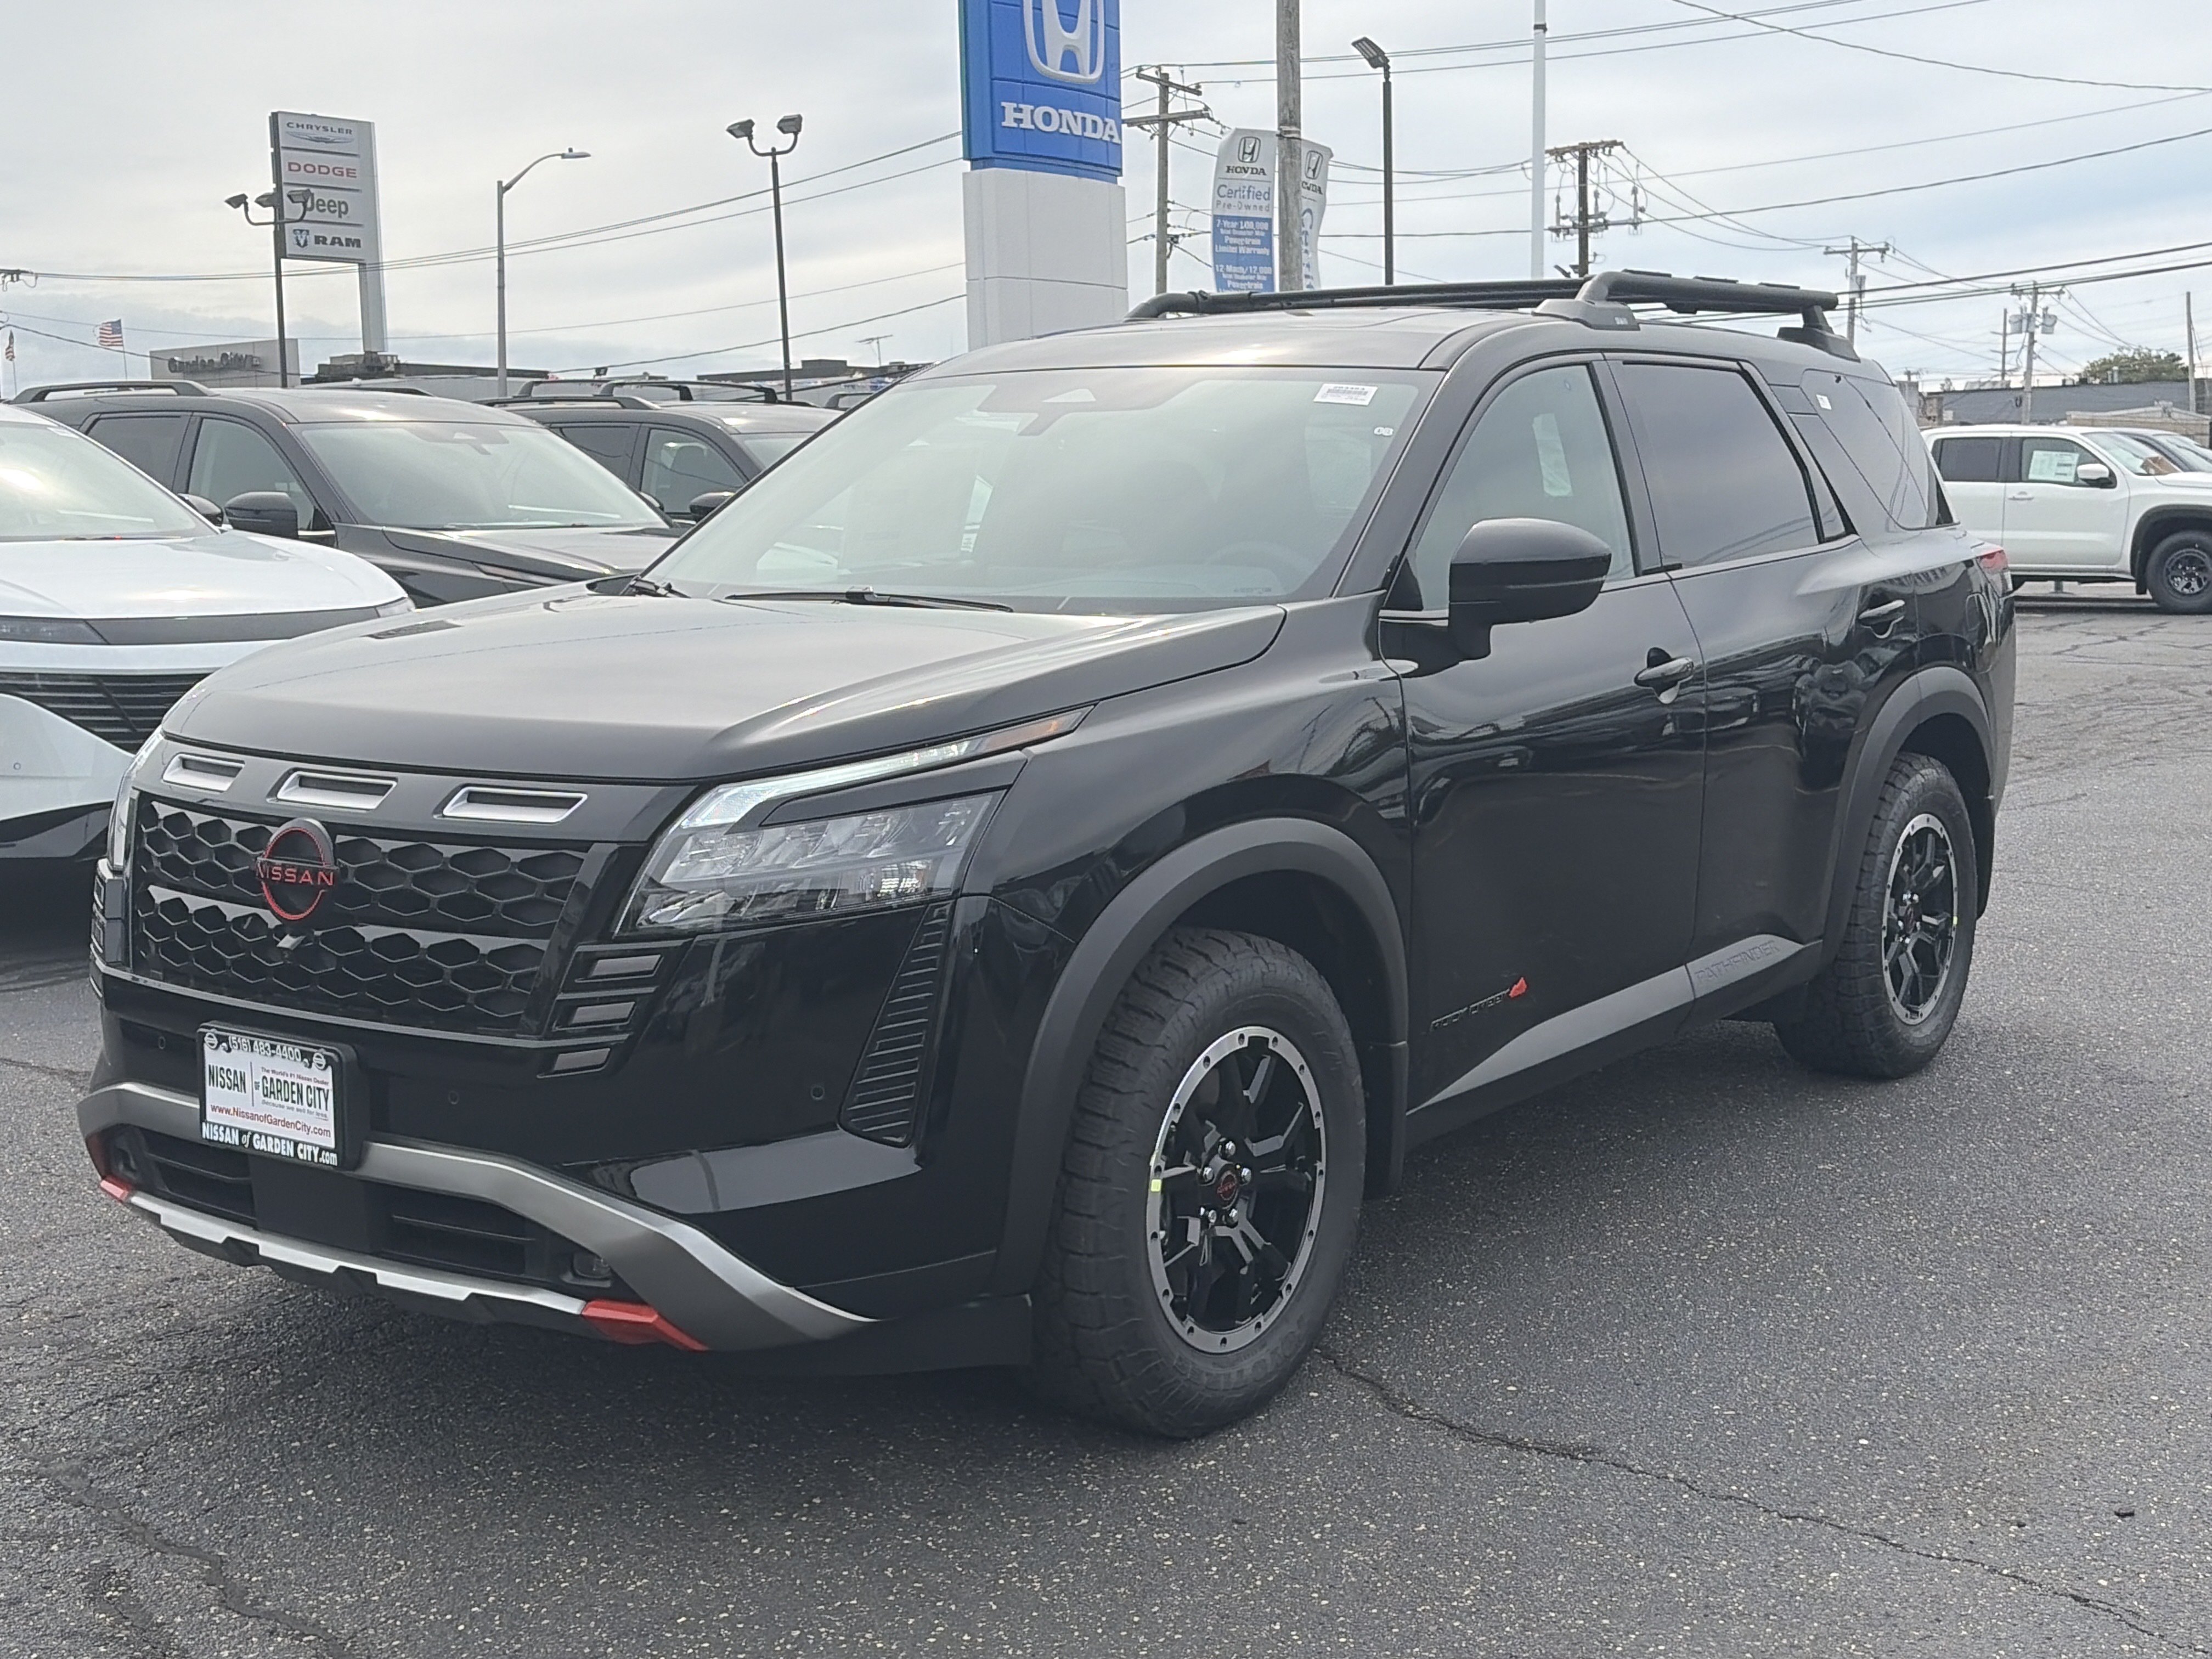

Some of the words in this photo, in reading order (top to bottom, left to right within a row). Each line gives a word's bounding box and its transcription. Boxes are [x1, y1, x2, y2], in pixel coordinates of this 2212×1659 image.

[286, 122, 353, 135] CHRYSLER
[1001, 101, 1121, 144] HONDA
[287, 162, 357, 178] DODGE
[1217, 184, 1271, 201] Certified
[305, 193, 349, 218] Jeep
[1216, 201, 1270, 212] Pre-Owned
[314, 235, 362, 248] RAM
[256, 861, 334, 886] NISSAN
[228, 1035, 251, 1051] (516)
[253, 1042, 301, 1062] 483-4400
[208, 1064, 247, 1094] NISSAN
[271, 1069, 289, 1077] World's
[262, 1075, 303, 1106] GARDEN
[306, 1084, 329, 1111] CITY
[211, 1104, 331, 1138] www.NissanofGardenCity.com
[202, 1121, 239, 1146] NISSAN
[241, 1132, 251, 1148] of
[252, 1133, 295, 1158] GARDEN
[297, 1144, 338, 1166] CITY.com
